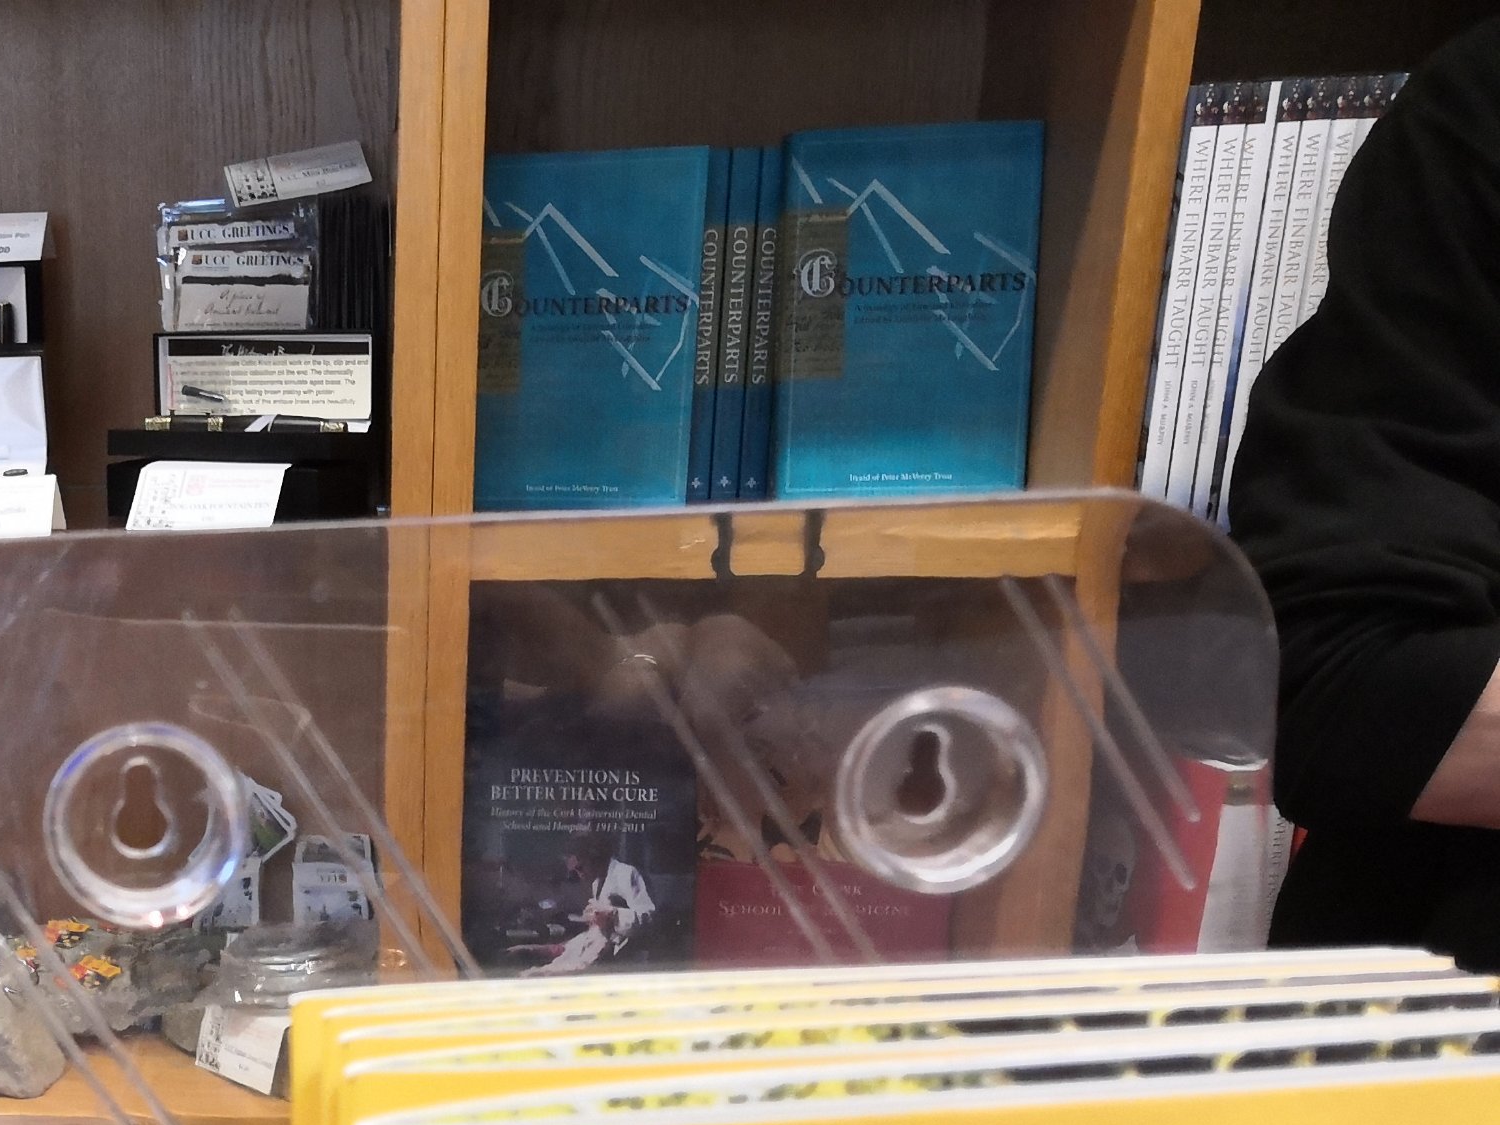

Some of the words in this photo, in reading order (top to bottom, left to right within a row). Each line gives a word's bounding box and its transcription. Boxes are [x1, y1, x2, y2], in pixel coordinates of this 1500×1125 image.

[1188, 138, 1211, 205] WHERE
[1215, 136, 1238, 204] WHERE
[1236, 137, 1258, 204] WHERE
[1297, 133, 1322, 200] WHERE
[204, 254, 231, 266] UCC
[236, 253, 305, 267] GREETINGS
[221, 223, 291, 240] GREETINGS
[1176, 211, 1200, 289] FINBARR
[1202, 210, 1227, 288] FINBARR
[1223, 211, 1245, 287] FINBARR
[1283, 207, 1310, 287] FINBARR
[480, 272, 690, 318] COUNTERPARTS
[694, 228, 720, 386] COUNTERPARTS
[723, 225, 749, 384] COUNTERPARTS
[751, 226, 777, 385] COUNTERPARTS
[793, 248, 1027, 298] COUNTERPARTS
[1164, 295, 1187, 368] TAUGHT
[1191, 295, 1215, 367] TAUGHT
[1213, 294, 1233, 368] TAUGHT
[490, 784, 556, 801] BETTER
[559, 786, 608, 802] THAN
[612, 787, 659, 803] CURE
[510, 768, 620, 785] PREVENTION
[624, 770, 641, 786] IS
